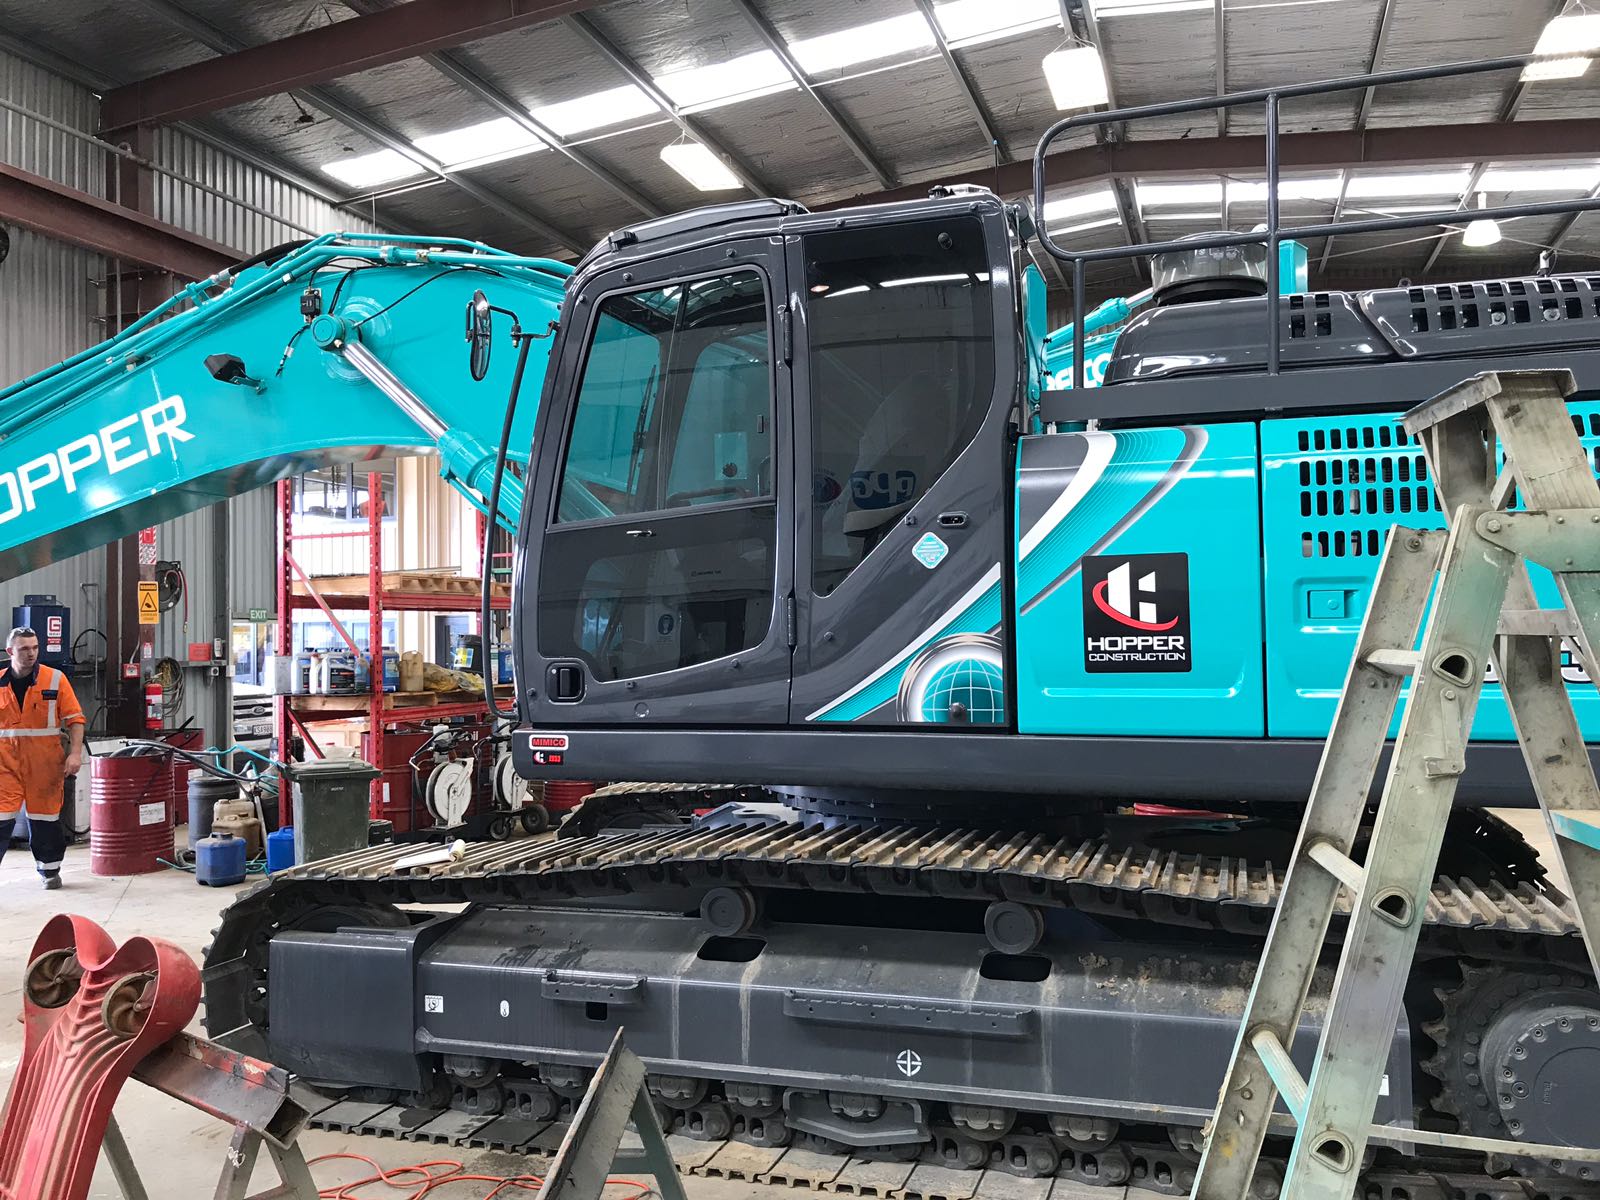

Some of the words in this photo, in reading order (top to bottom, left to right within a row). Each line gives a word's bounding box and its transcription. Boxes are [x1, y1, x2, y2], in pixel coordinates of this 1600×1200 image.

[250, 610, 267, 619] EXIT
[1087, 636, 1185, 651] HOPPER
[1089, 652, 1185, 661] CONSTRUCTION
[532, 738, 565, 746] MIMICO
